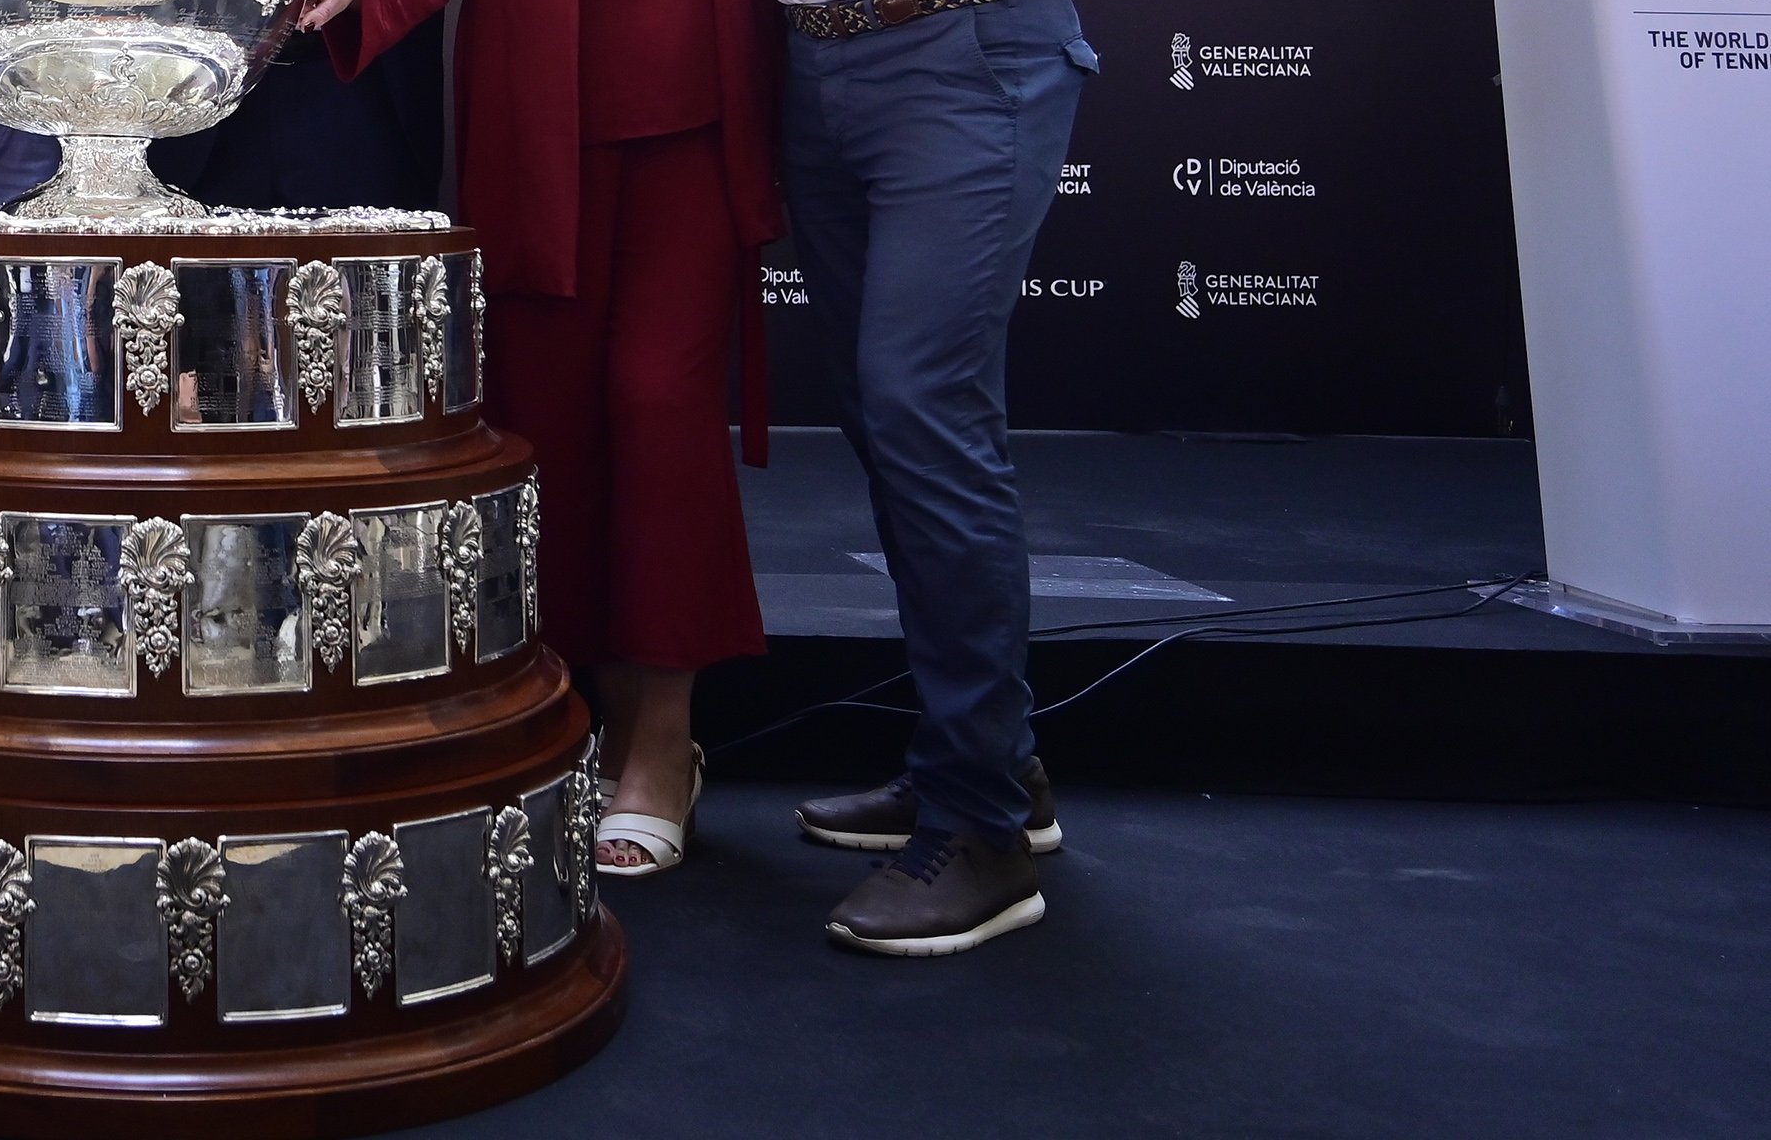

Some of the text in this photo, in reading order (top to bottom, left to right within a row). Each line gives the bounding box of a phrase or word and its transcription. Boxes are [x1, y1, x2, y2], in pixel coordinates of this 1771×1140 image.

[1647, 30, 1769, 50] THE WORLD
[1199, 45, 1314, 60] GENERALITAT
[1679, 51, 1706, 69] OF
[1201, 62, 1312, 77] VALENCIANA
[1219, 158, 1301, 179] Diputació
[1219, 180, 1316, 197] de València
[1050, 279, 1104, 297] CUP
[1205, 274, 1320, 289] GENERALITAT
[1207, 291, 1317, 306] VALENCIANA
